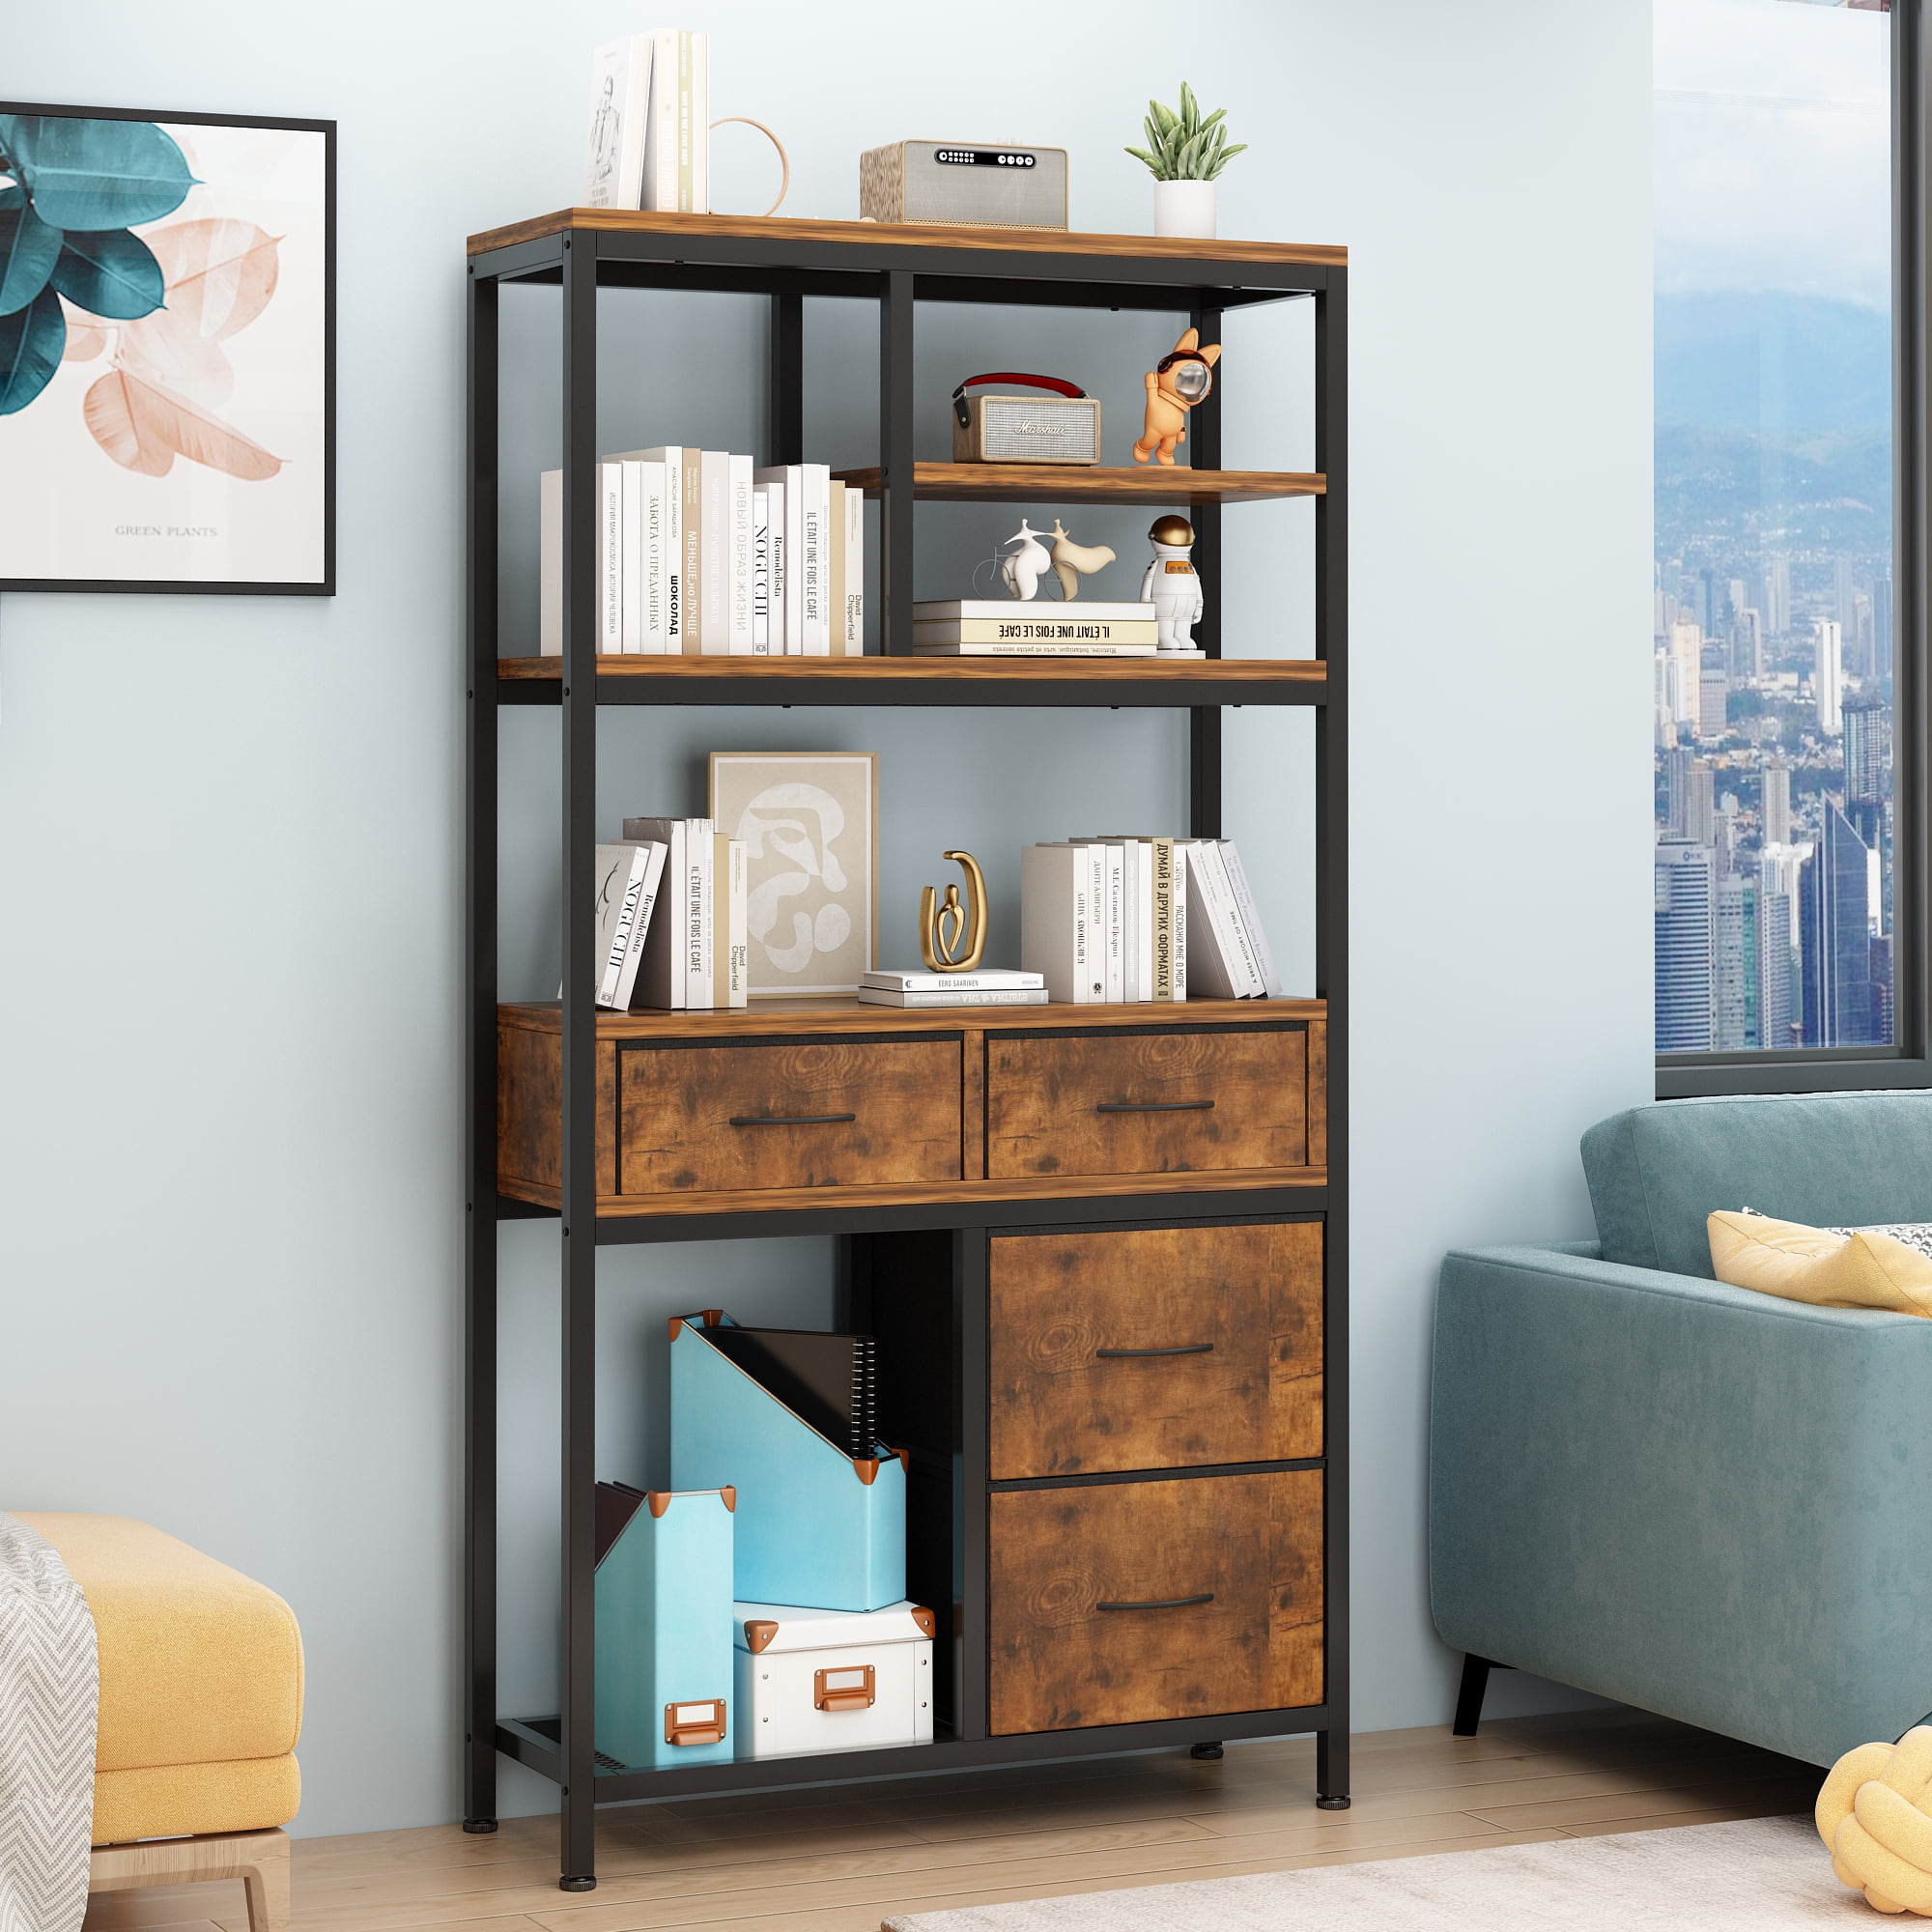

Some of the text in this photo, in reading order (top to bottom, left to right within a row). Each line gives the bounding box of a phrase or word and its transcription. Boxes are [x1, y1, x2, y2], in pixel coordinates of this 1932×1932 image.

[1014, 419, 1067, 435] Marshall
[609, 492, 617, 520] ИСТОРИЯ
[649, 495, 660, 539] ЗАБОТА
[115, 525, 217, 537] GREEN PLANTS
[807, 522, 819, 545] ÉTAIT
[736, 481, 750, 632] НОВЫЙ ОБРАЗ ЖИЗНИ
[754, 525, 768, 616] NOGUCHI
[774, 536, 783, 598] Remodelista
[807, 547, 817, 563] UNE
[609, 574, 617, 603] ИСТОРИЯ
[807, 566, 817, 584] FOIS
[807, 587, 817, 596] LE
[648, 556, 660, 632] ПРЕДАННЫХ
[669, 575, 679, 636] ШОКОЛАД
[807, 598, 819, 621] CAFÉ
[854, 594, 863, 616] David
[609, 604, 617, 635] ЧЕЛОВЕКА
[686, 598, 697, 638] ЛУЧШЕ
[846, 594, 856, 641] Chipperfield
[998, 625, 1110, 640] IL ÉTAIT UNE FOIS LE CAFÉ
[1156, 844, 1171, 879] ДУМАЙ
[609, 877, 642, 968] NOGUCHI
[632, 895, 655, 953] Remodelista
[691, 866, 703, 974] IL ÉTAIT UNE FOIS LE CAFÉ
[1156, 893, 1169, 931] ДРУГИХ
[1175, 905, 1184, 943] РАССКАЖИ
[1158, 933, 1169, 987] ФОРМАТАХ
[1175, 945, 1184, 960] МНЕ
[1238, 936, 1250, 961] HISTORY
[730, 945, 740, 991] Chipperfield
[1175, 970, 1184, 989] МОРЕ
[1247, 963, 1256, 978] BRIEF
